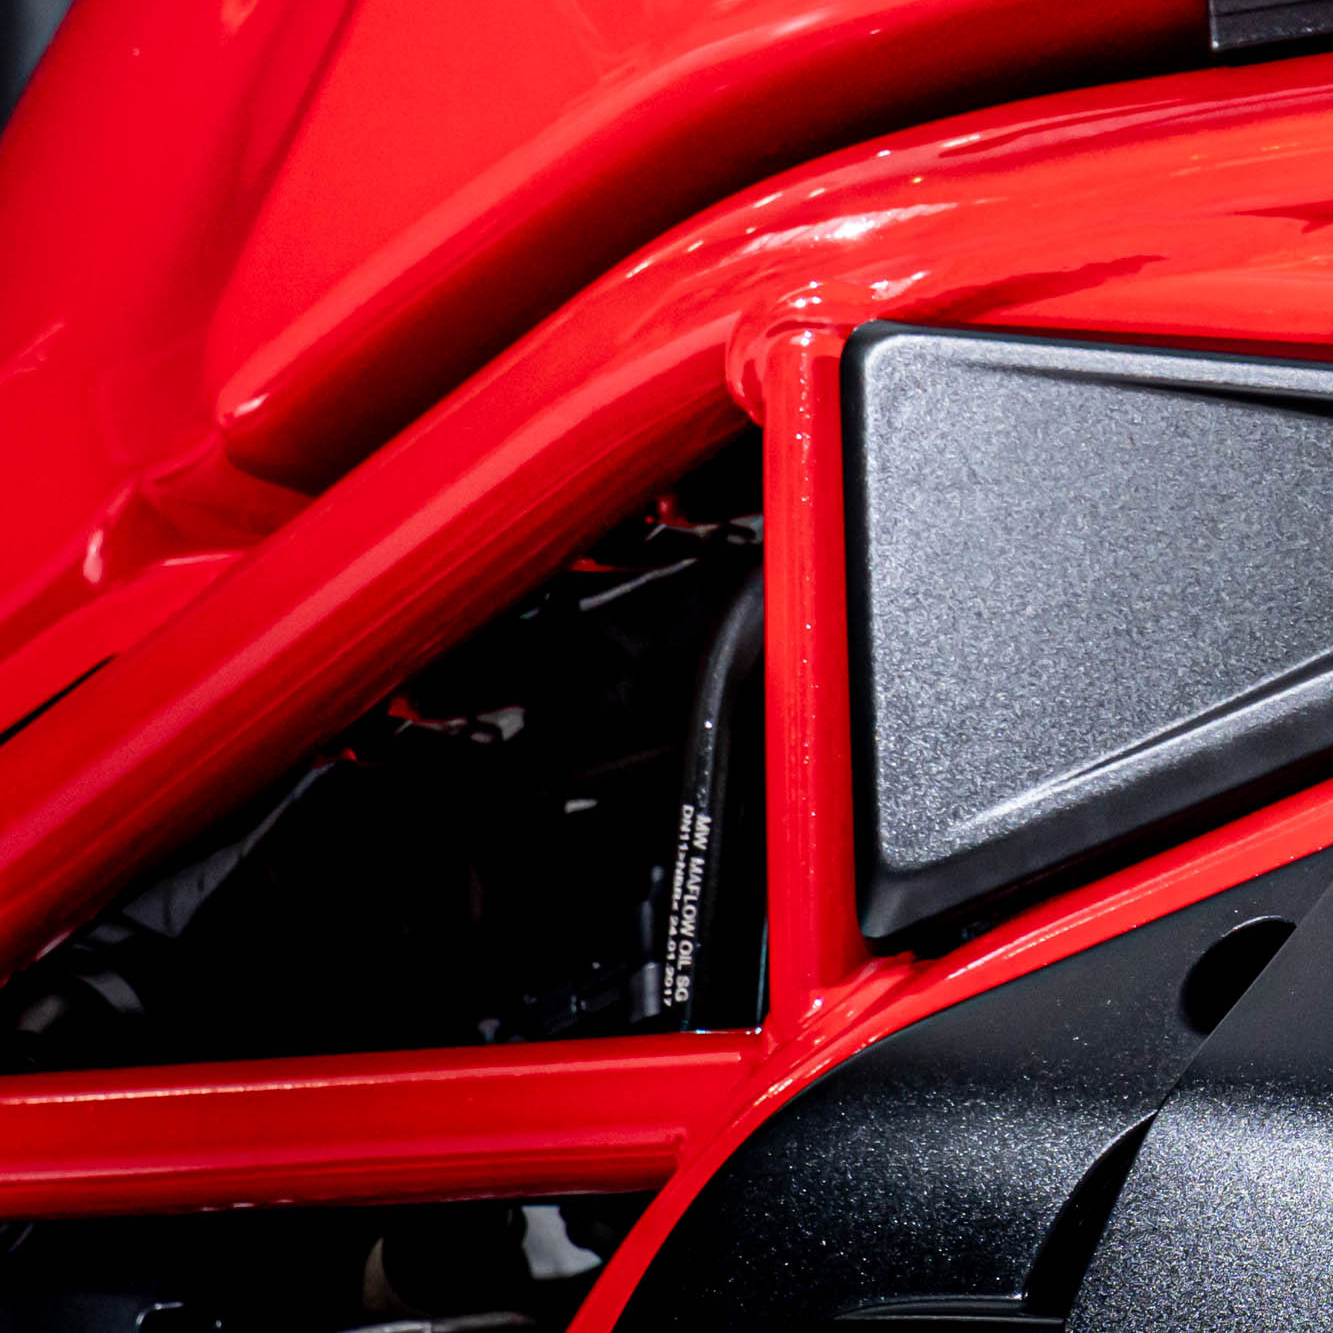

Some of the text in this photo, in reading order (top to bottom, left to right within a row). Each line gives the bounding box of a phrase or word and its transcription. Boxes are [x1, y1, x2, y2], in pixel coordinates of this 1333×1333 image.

[675, 814, 712, 1002] MW MAFLOW OIL SG
